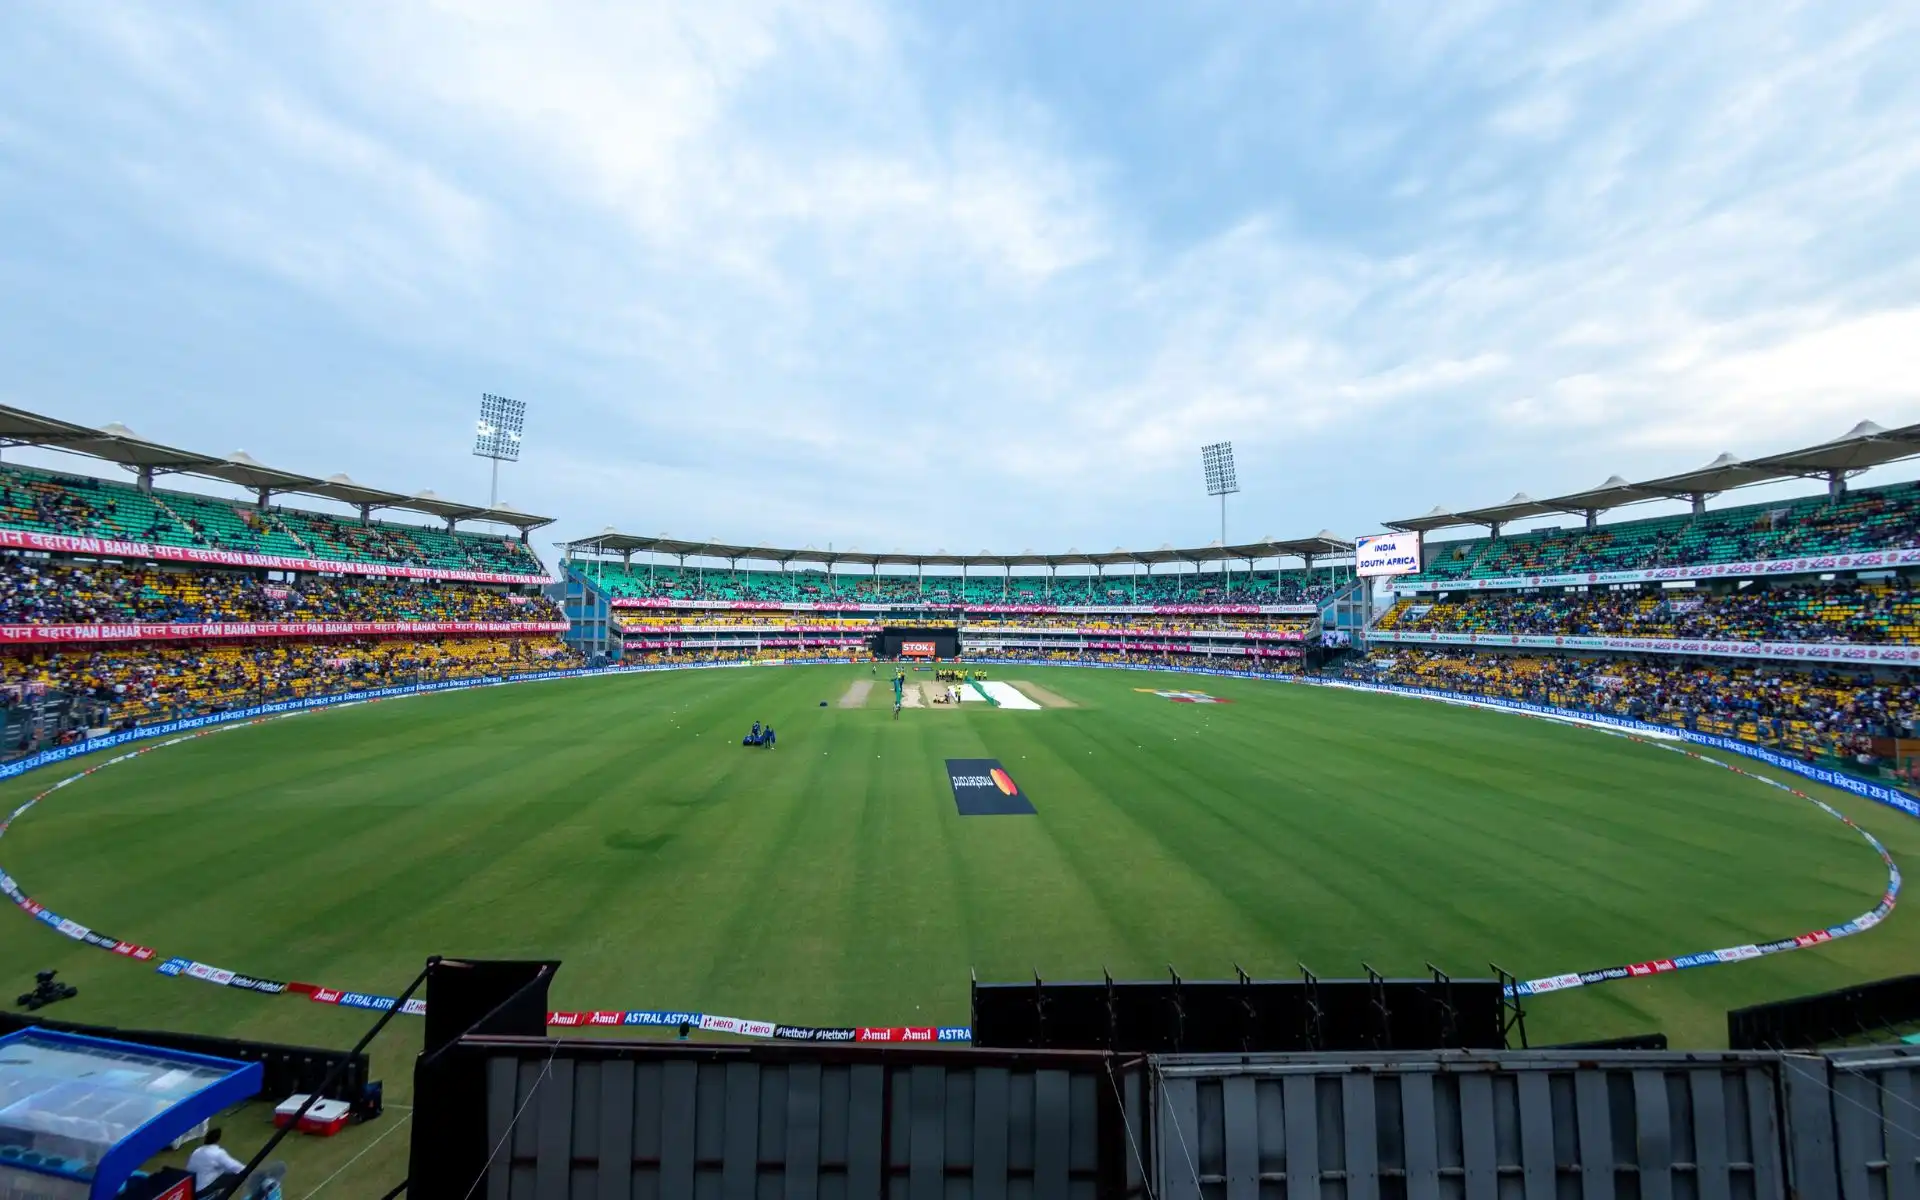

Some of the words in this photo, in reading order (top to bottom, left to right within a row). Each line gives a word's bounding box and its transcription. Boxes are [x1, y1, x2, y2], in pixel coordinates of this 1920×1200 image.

[0, 531, 23, 544] ान
[71, 538, 100, 552] PAN
[104, 540, 149, 556] BAHAR
[222, 552, 242, 565] PAN
[246, 555, 281, 567] BAHAR
[336, 562, 354, 573] PAN
[356, 563, 387, 575] BAHAR
[1375, 543, 1396, 552] INDIA
[1360, 560, 1385, 568] SOUTH
[1387, 556, 1415, 566] AFRICA
[75, 626, 98, 639] PAN
[102, 625, 141, 638] BAHAR
[202, 625, 222, 635] PAN
[224, 624, 256, 635] BAHAR
[307, 624, 323, 633] PAN
[325, 624, 353, 633] BAHAR
[396, 623, 411, 632] PAN
[412, 623, 437, 631] BAHAR
[953, 776, 994, 790] mastercard
[314, 988, 340, 1002] Amul
[1504, 984, 1532, 997] ASRAL
[340, 993, 371, 1006] ASTRAL
[371, 998, 399, 1010] ASTR
[548, 1011, 578, 1024] Amul
[590, 1011, 619, 1024] Amul
[625, 1012, 661, 1024] ASTRAL
[663, 1013, 700, 1025] ASTRAL
[781, 1026, 808, 1038] Hettich
[822, 1028, 849, 1040] Hettich
[861, 1027, 891, 1041] Amul
[902, 1027, 931, 1041] Amul
